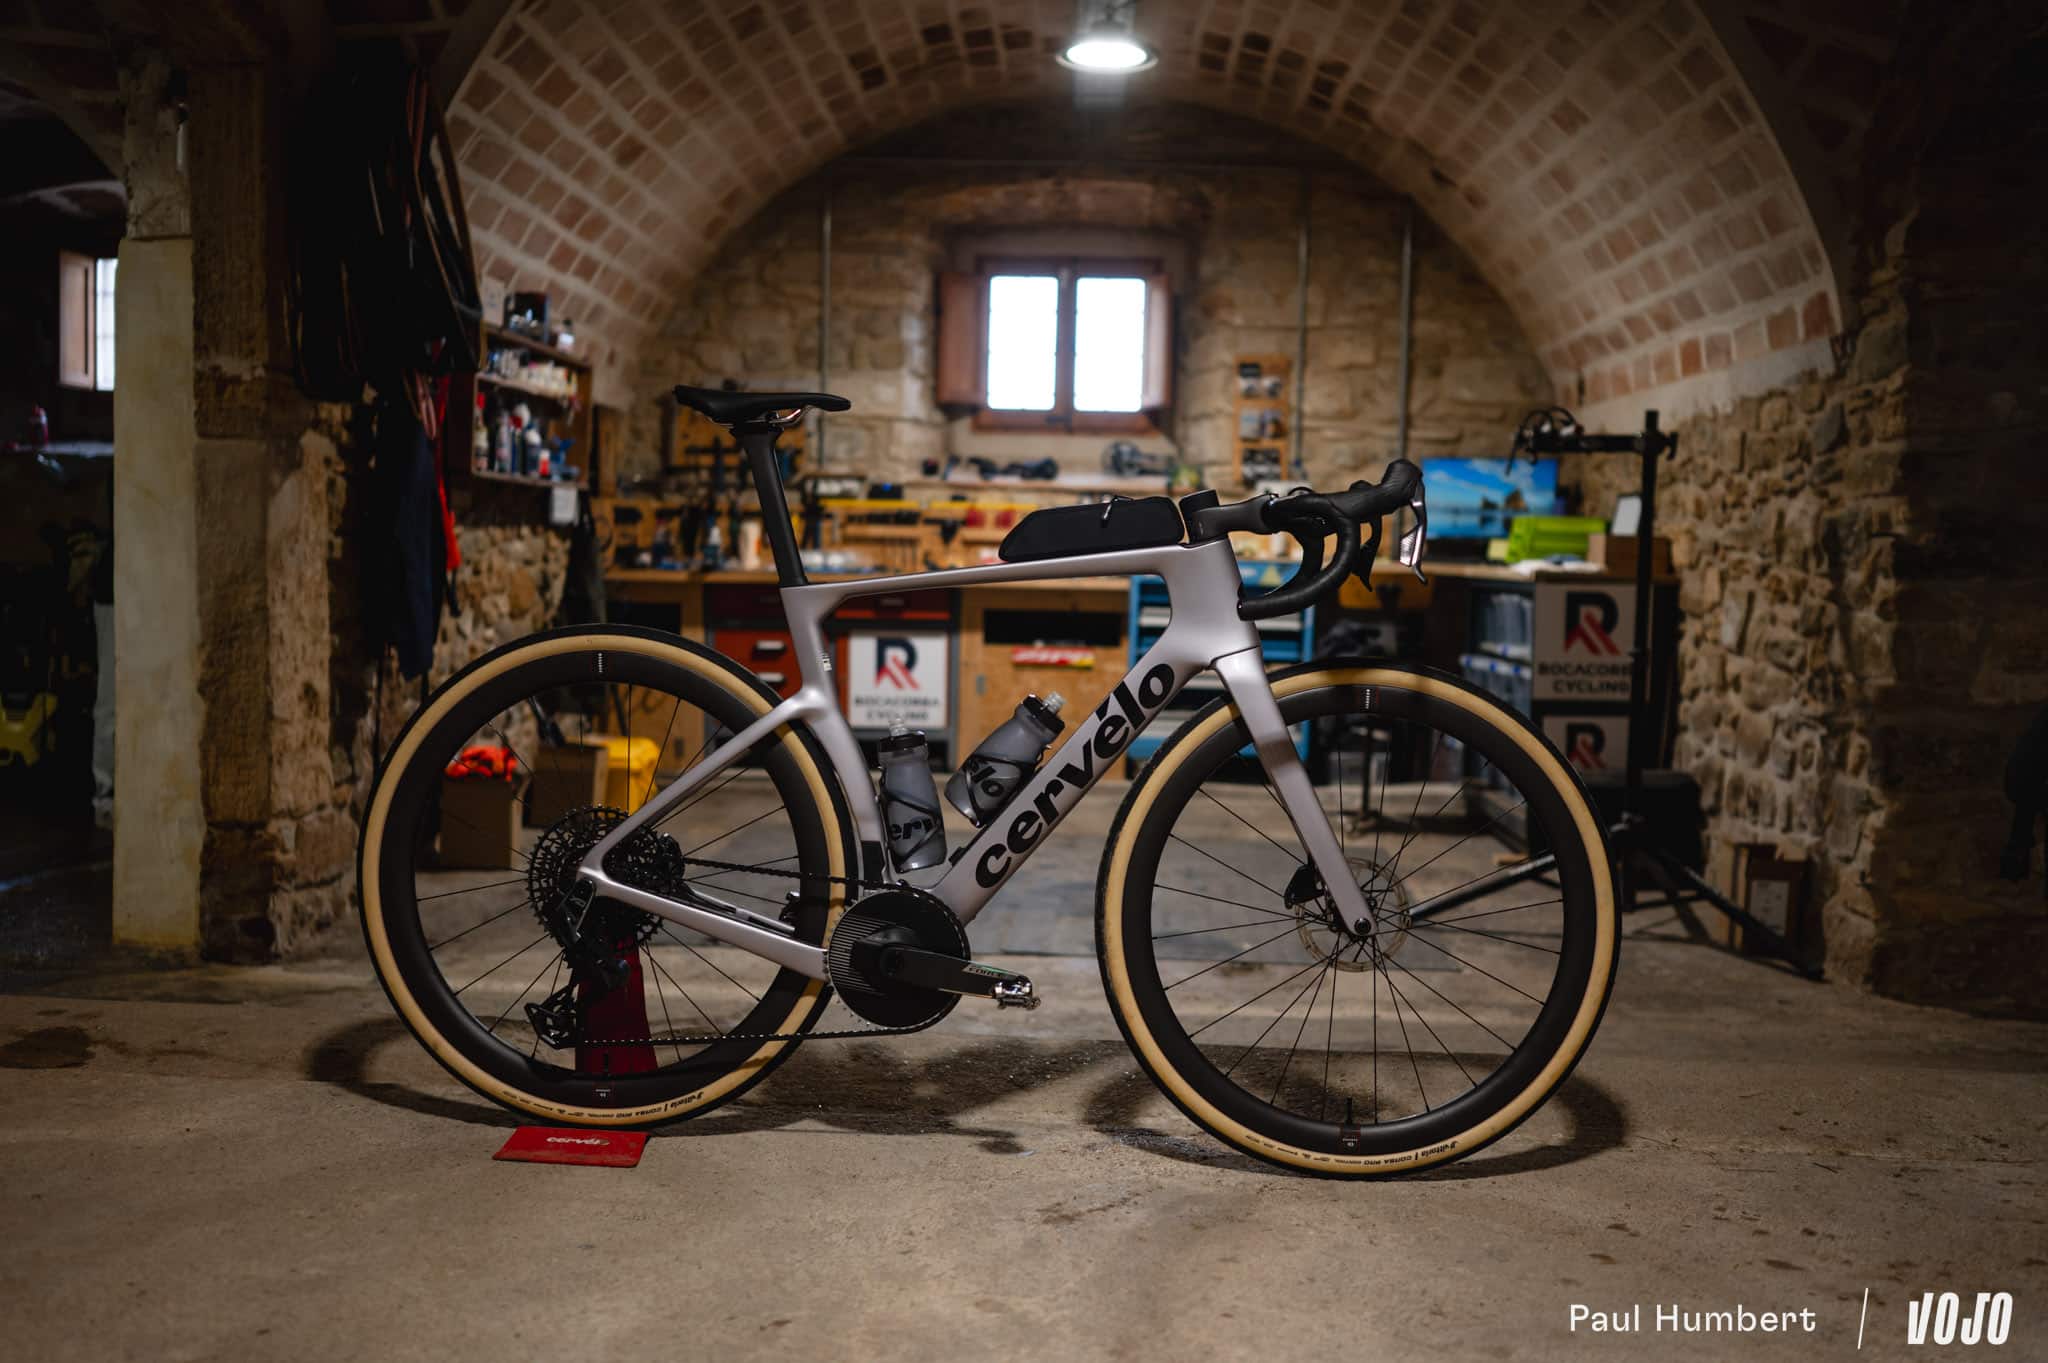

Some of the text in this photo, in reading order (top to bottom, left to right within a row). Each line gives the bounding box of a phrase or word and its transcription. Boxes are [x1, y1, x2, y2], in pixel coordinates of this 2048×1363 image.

[1538, 661, 1634, 676] ROCACORB
[1553, 679, 1631, 694] CYCLING
[975, 663, 1175, 889] cervélo
[1421, 1143, 1450, 1158] vittoria
[1384, 1155, 1413, 1165] CORSA
